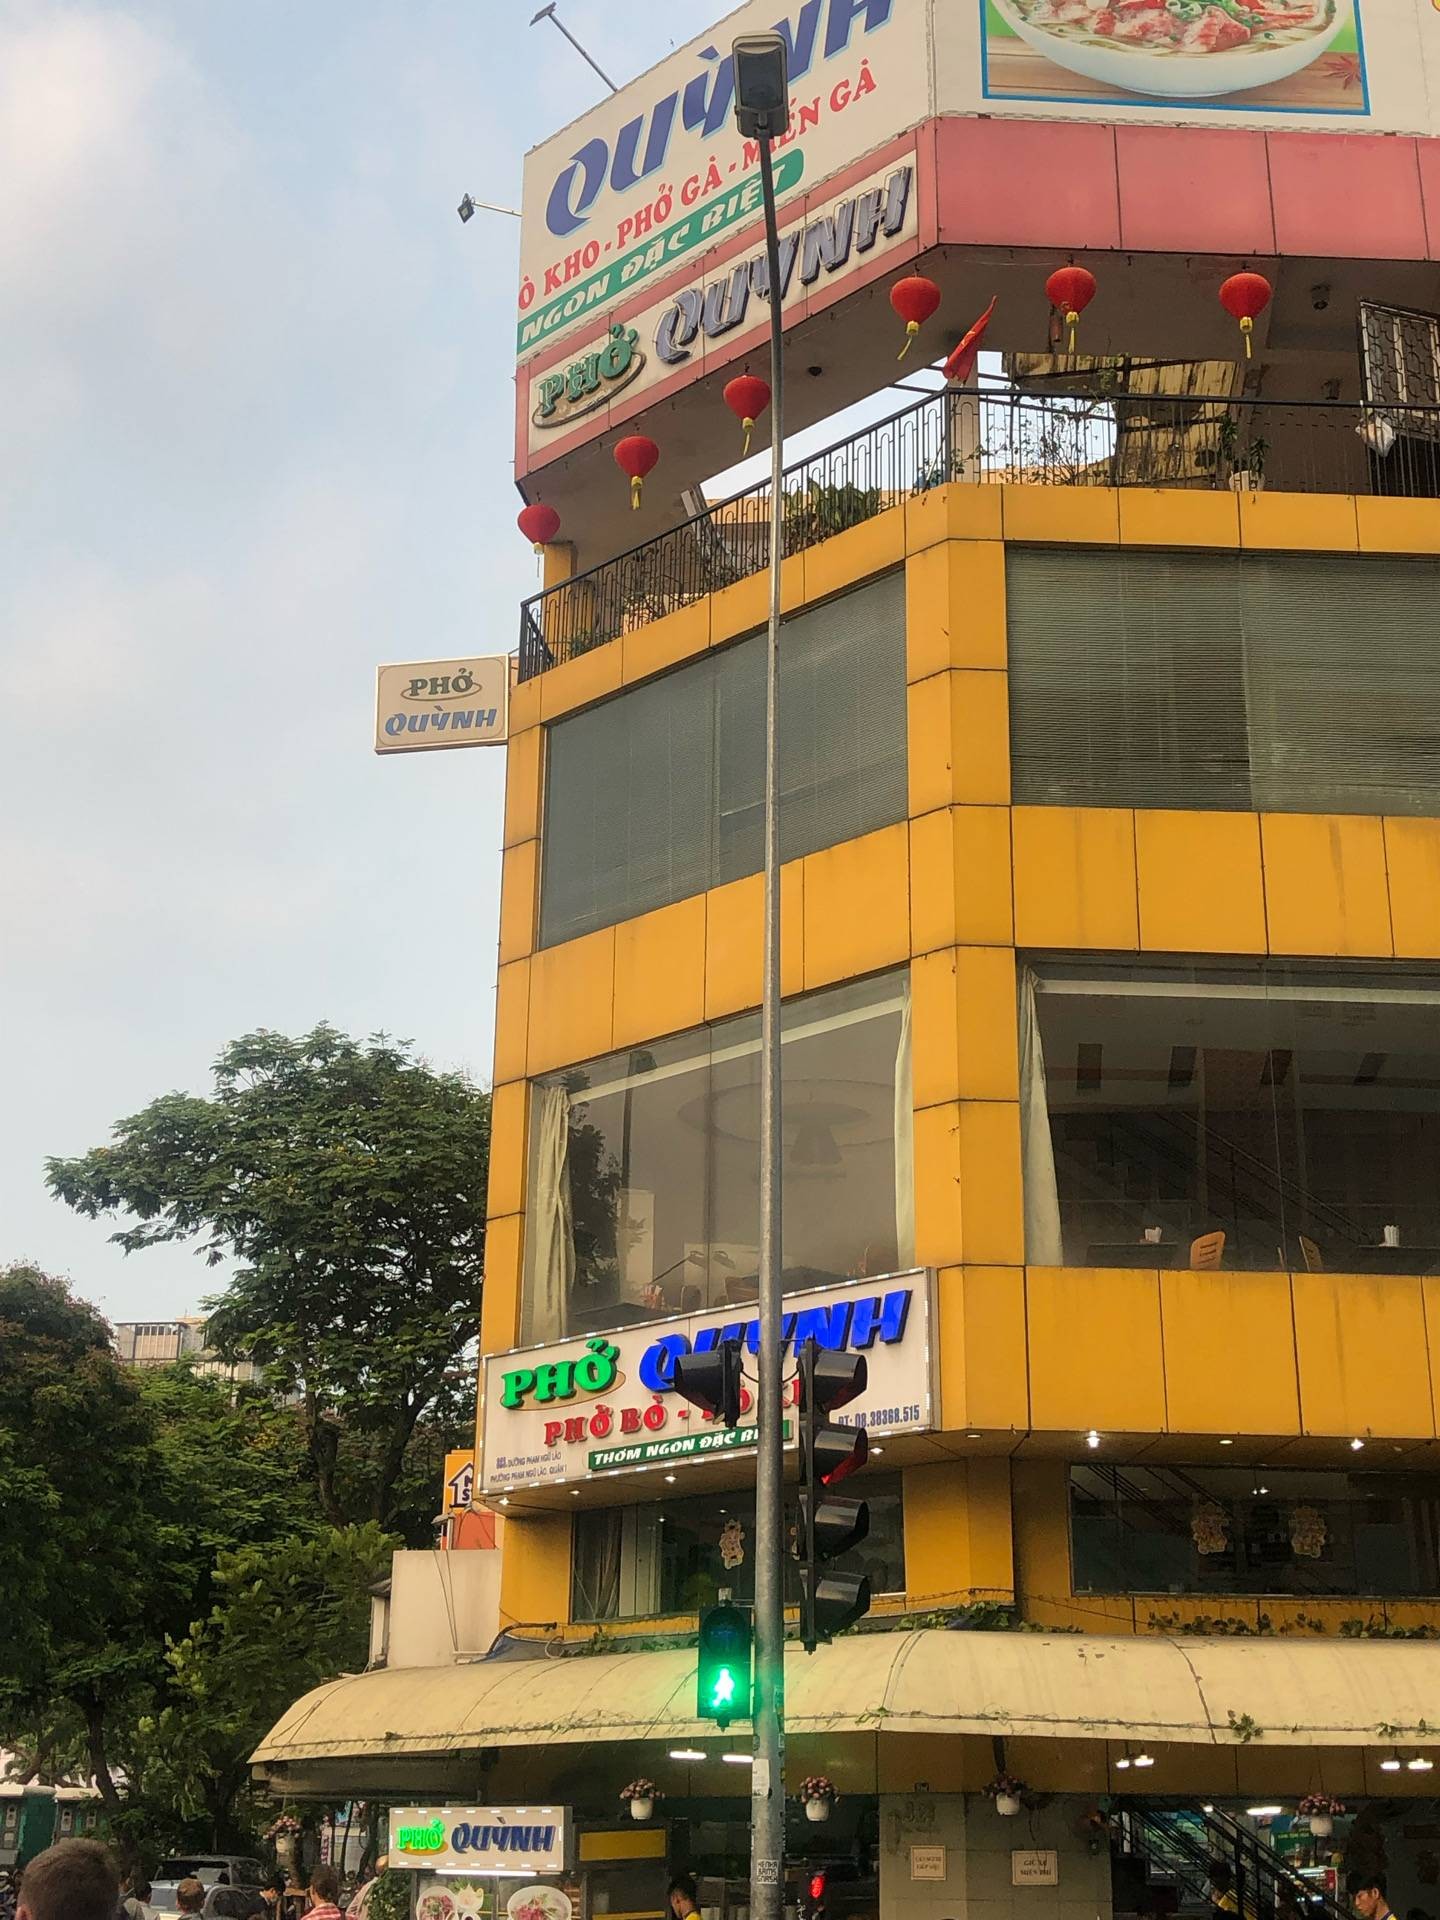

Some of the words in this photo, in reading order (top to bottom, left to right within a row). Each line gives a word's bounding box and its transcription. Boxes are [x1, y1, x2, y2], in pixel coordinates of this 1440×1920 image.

[544, 240, 600, 297] KHO
[617, 182, 673, 250] PHỞ
[521, 276, 609, 345] NGON
[621, 223, 692, 283] ĐẶC
[537, 324, 639, 418] PHỞ
[408, 668, 474, 697] PHỞ
[385, 705, 497, 736] QUỲNH
[501, 1337, 620, 1410] PHỞ
[544, 1404, 614, 1448] PHỞ
[620, 1394, 668, 1434] BÒ
[594, 1447, 641, 1466] THƠM
[646, 1437, 695, 1458] NGON
[397, 1816, 445, 1851] PHỞ
[451, 1816, 557, 1855] QUỲNH
